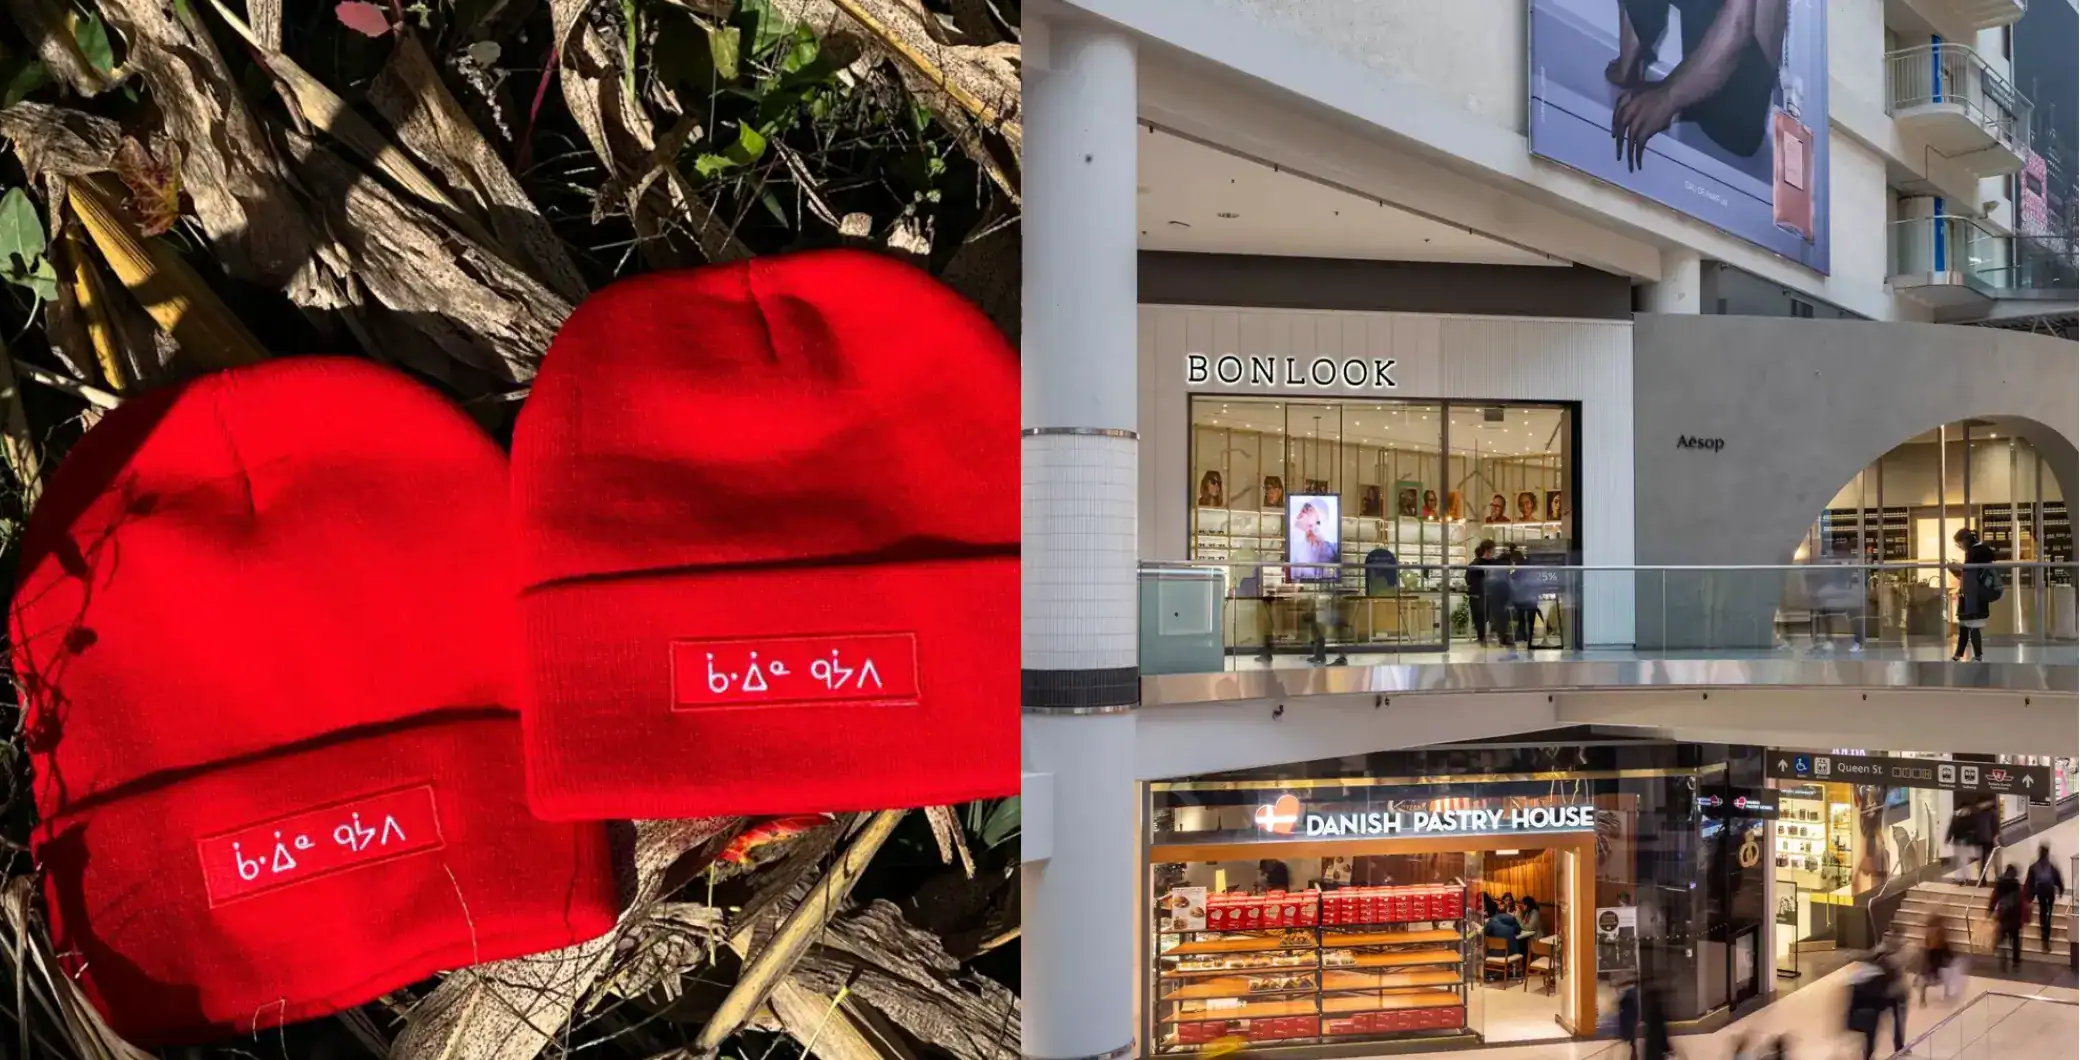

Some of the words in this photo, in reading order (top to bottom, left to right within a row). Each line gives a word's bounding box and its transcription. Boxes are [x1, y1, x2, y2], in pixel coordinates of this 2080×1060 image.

[1187, 353, 1398, 388] BONLOOK
[1676, 434, 1725, 453] Aesop
[1837, 762, 1870, 774] Queen
[1306, 813, 1401, 837] DANISH
[1413, 809, 1504, 832] PASTRY
[1511, 806, 1595, 829] HOUSE
